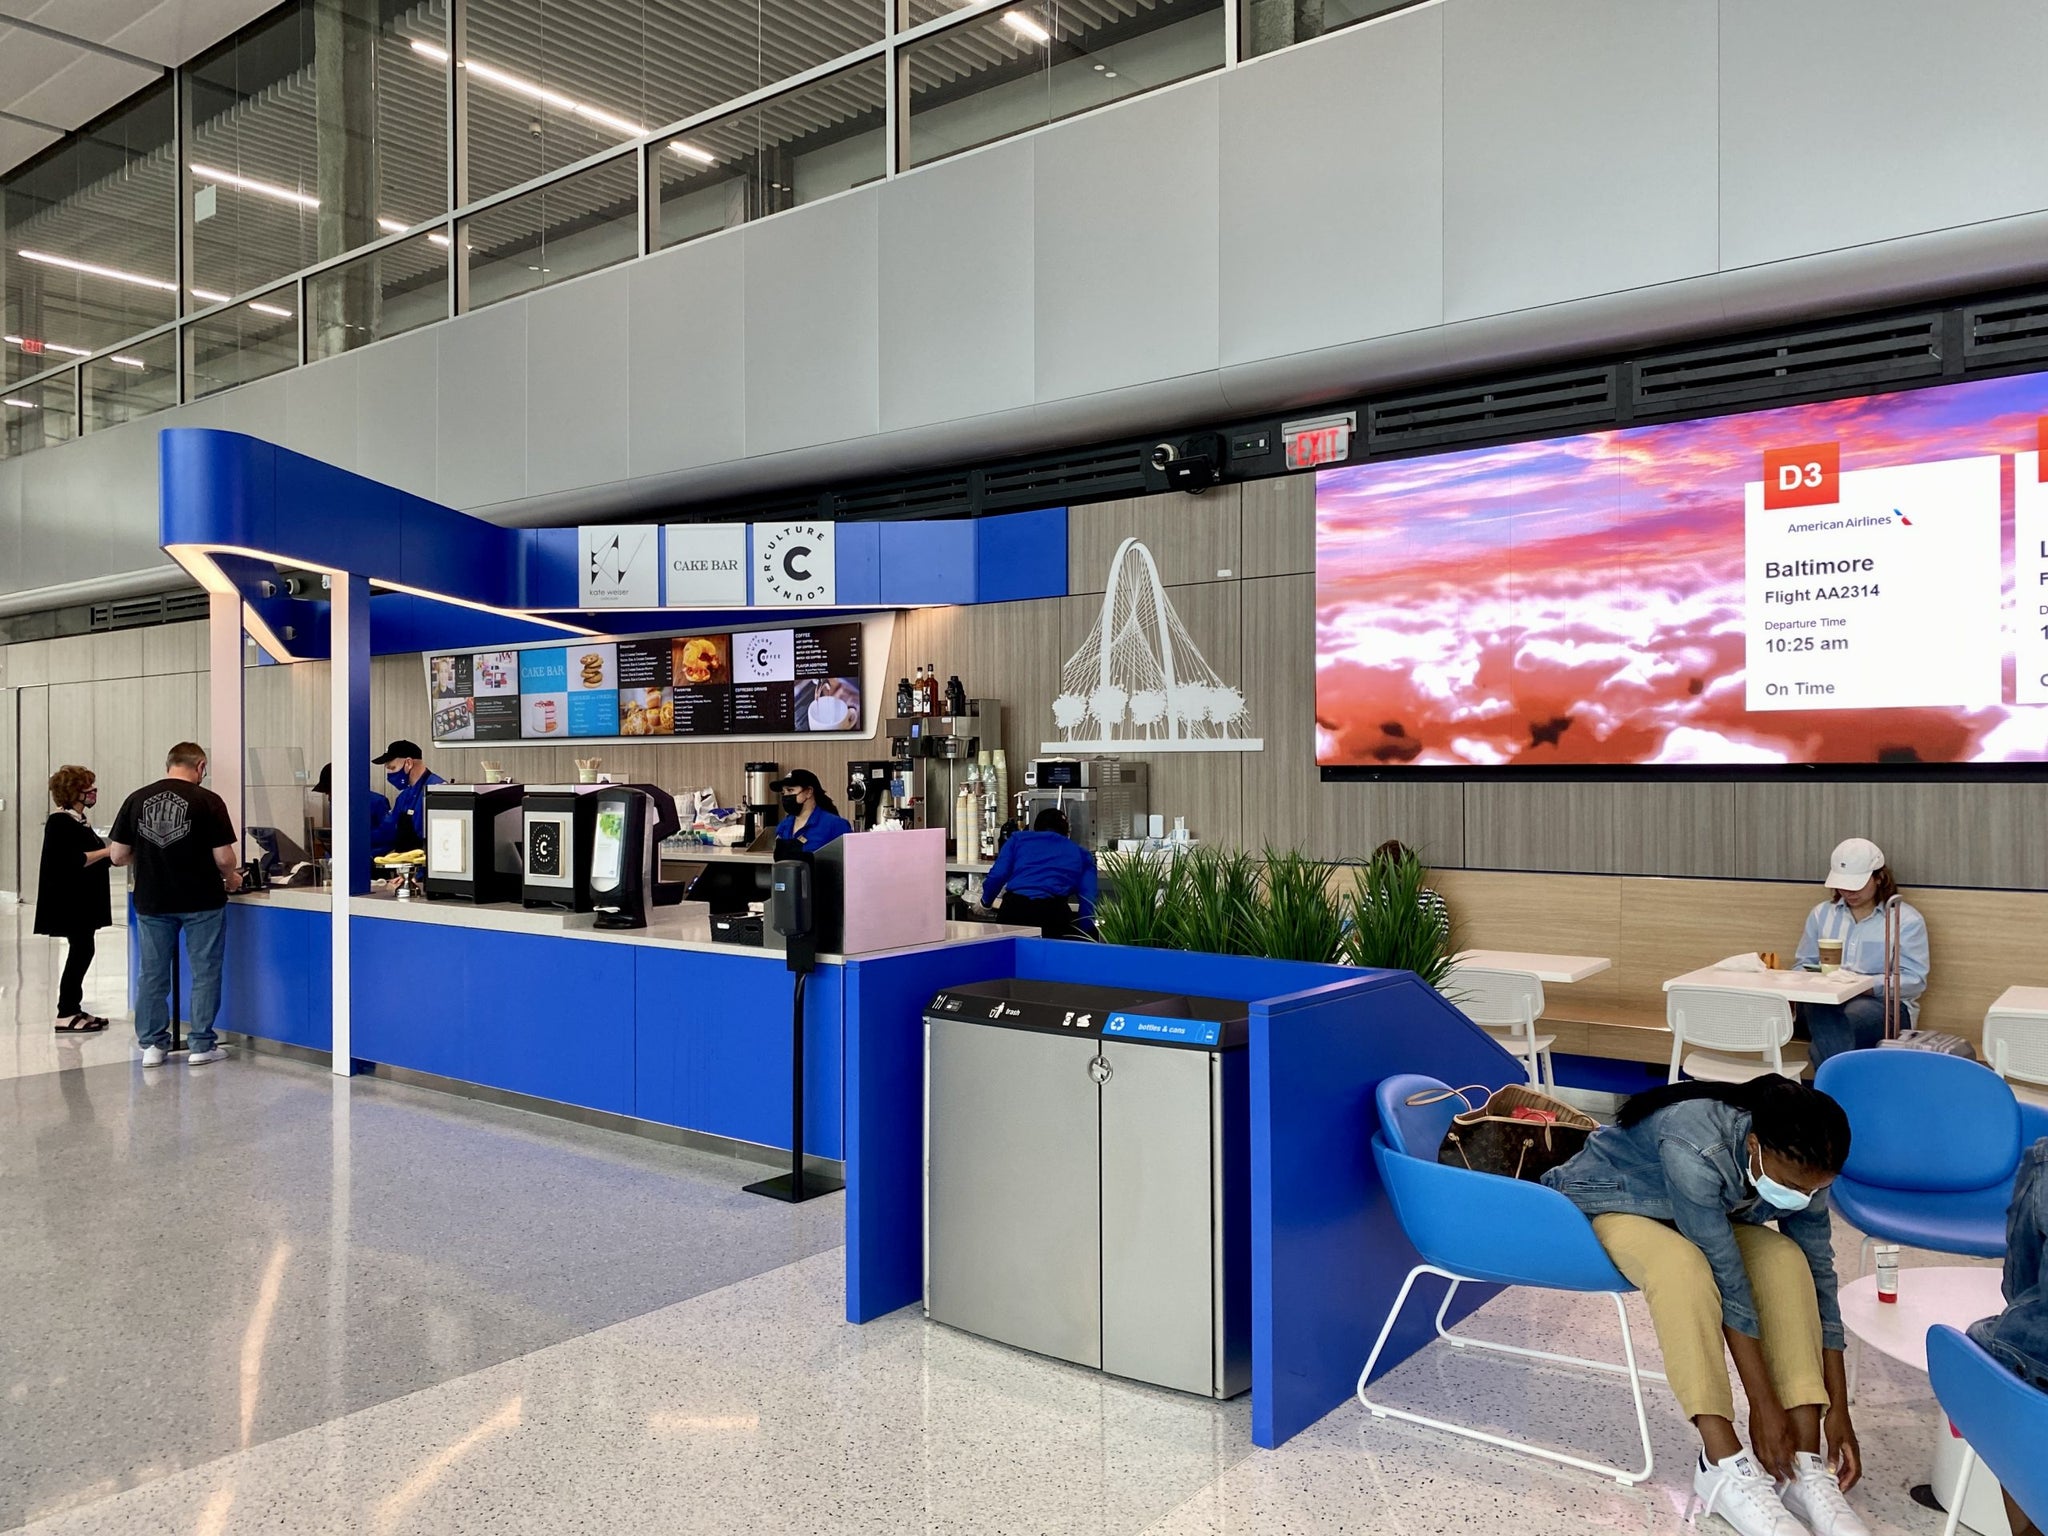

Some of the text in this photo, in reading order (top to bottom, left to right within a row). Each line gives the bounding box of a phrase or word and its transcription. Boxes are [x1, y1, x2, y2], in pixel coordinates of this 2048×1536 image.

[1296, 430, 1338, 466] EXIT
[1779, 462, 1823, 490] D3
[1788, 515, 1892, 533] American Airlines
[673, 560, 738, 571] CAKE BAR
[783, 546, 812, 581] C
[1765, 558, 1875, 579] Baltimore
[1765, 584, 1881, 605] Flight AA2314
[1764, 616, 1847, 633] Departure Time
[1765, 637, 1849, 653] 10:25 am
[522, 665, 565, 678] CAKE BAR
[1766, 682, 1835, 696] On Time
[147, 800, 182, 829] SPEED
[1005, 1008, 1021, 1016] trash
[1138, 1023, 1161, 1032] bottles
